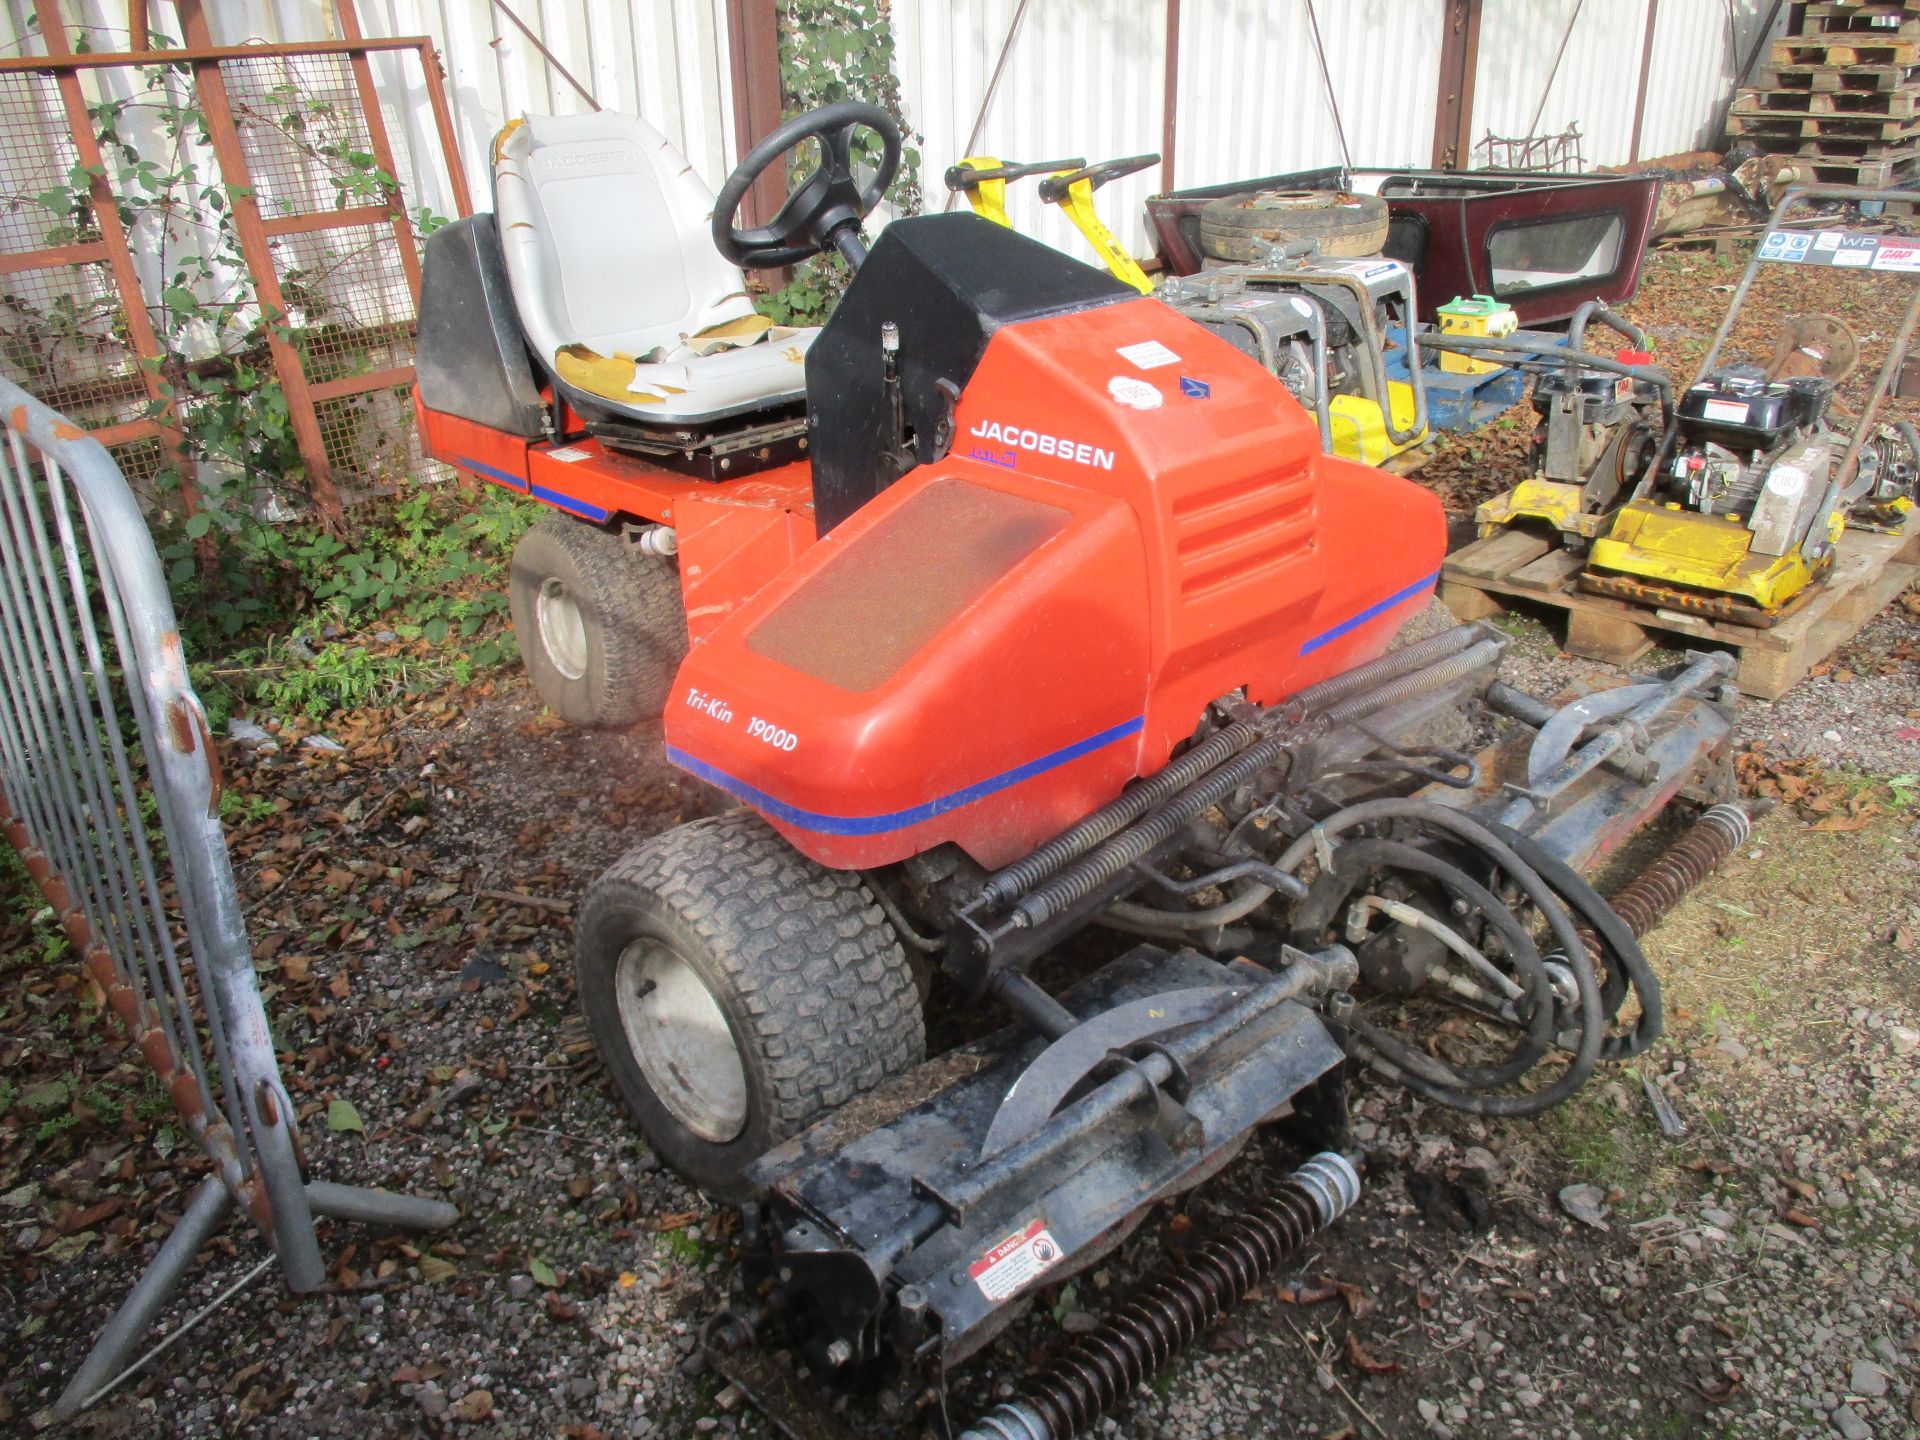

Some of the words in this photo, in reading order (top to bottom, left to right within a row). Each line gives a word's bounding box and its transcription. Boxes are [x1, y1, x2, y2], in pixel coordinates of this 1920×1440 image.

[970, 419, 1115, 471] JACOBSEN
[685, 687, 734, 724] Tri-Kin
[746, 716, 798, 752] 1900D
